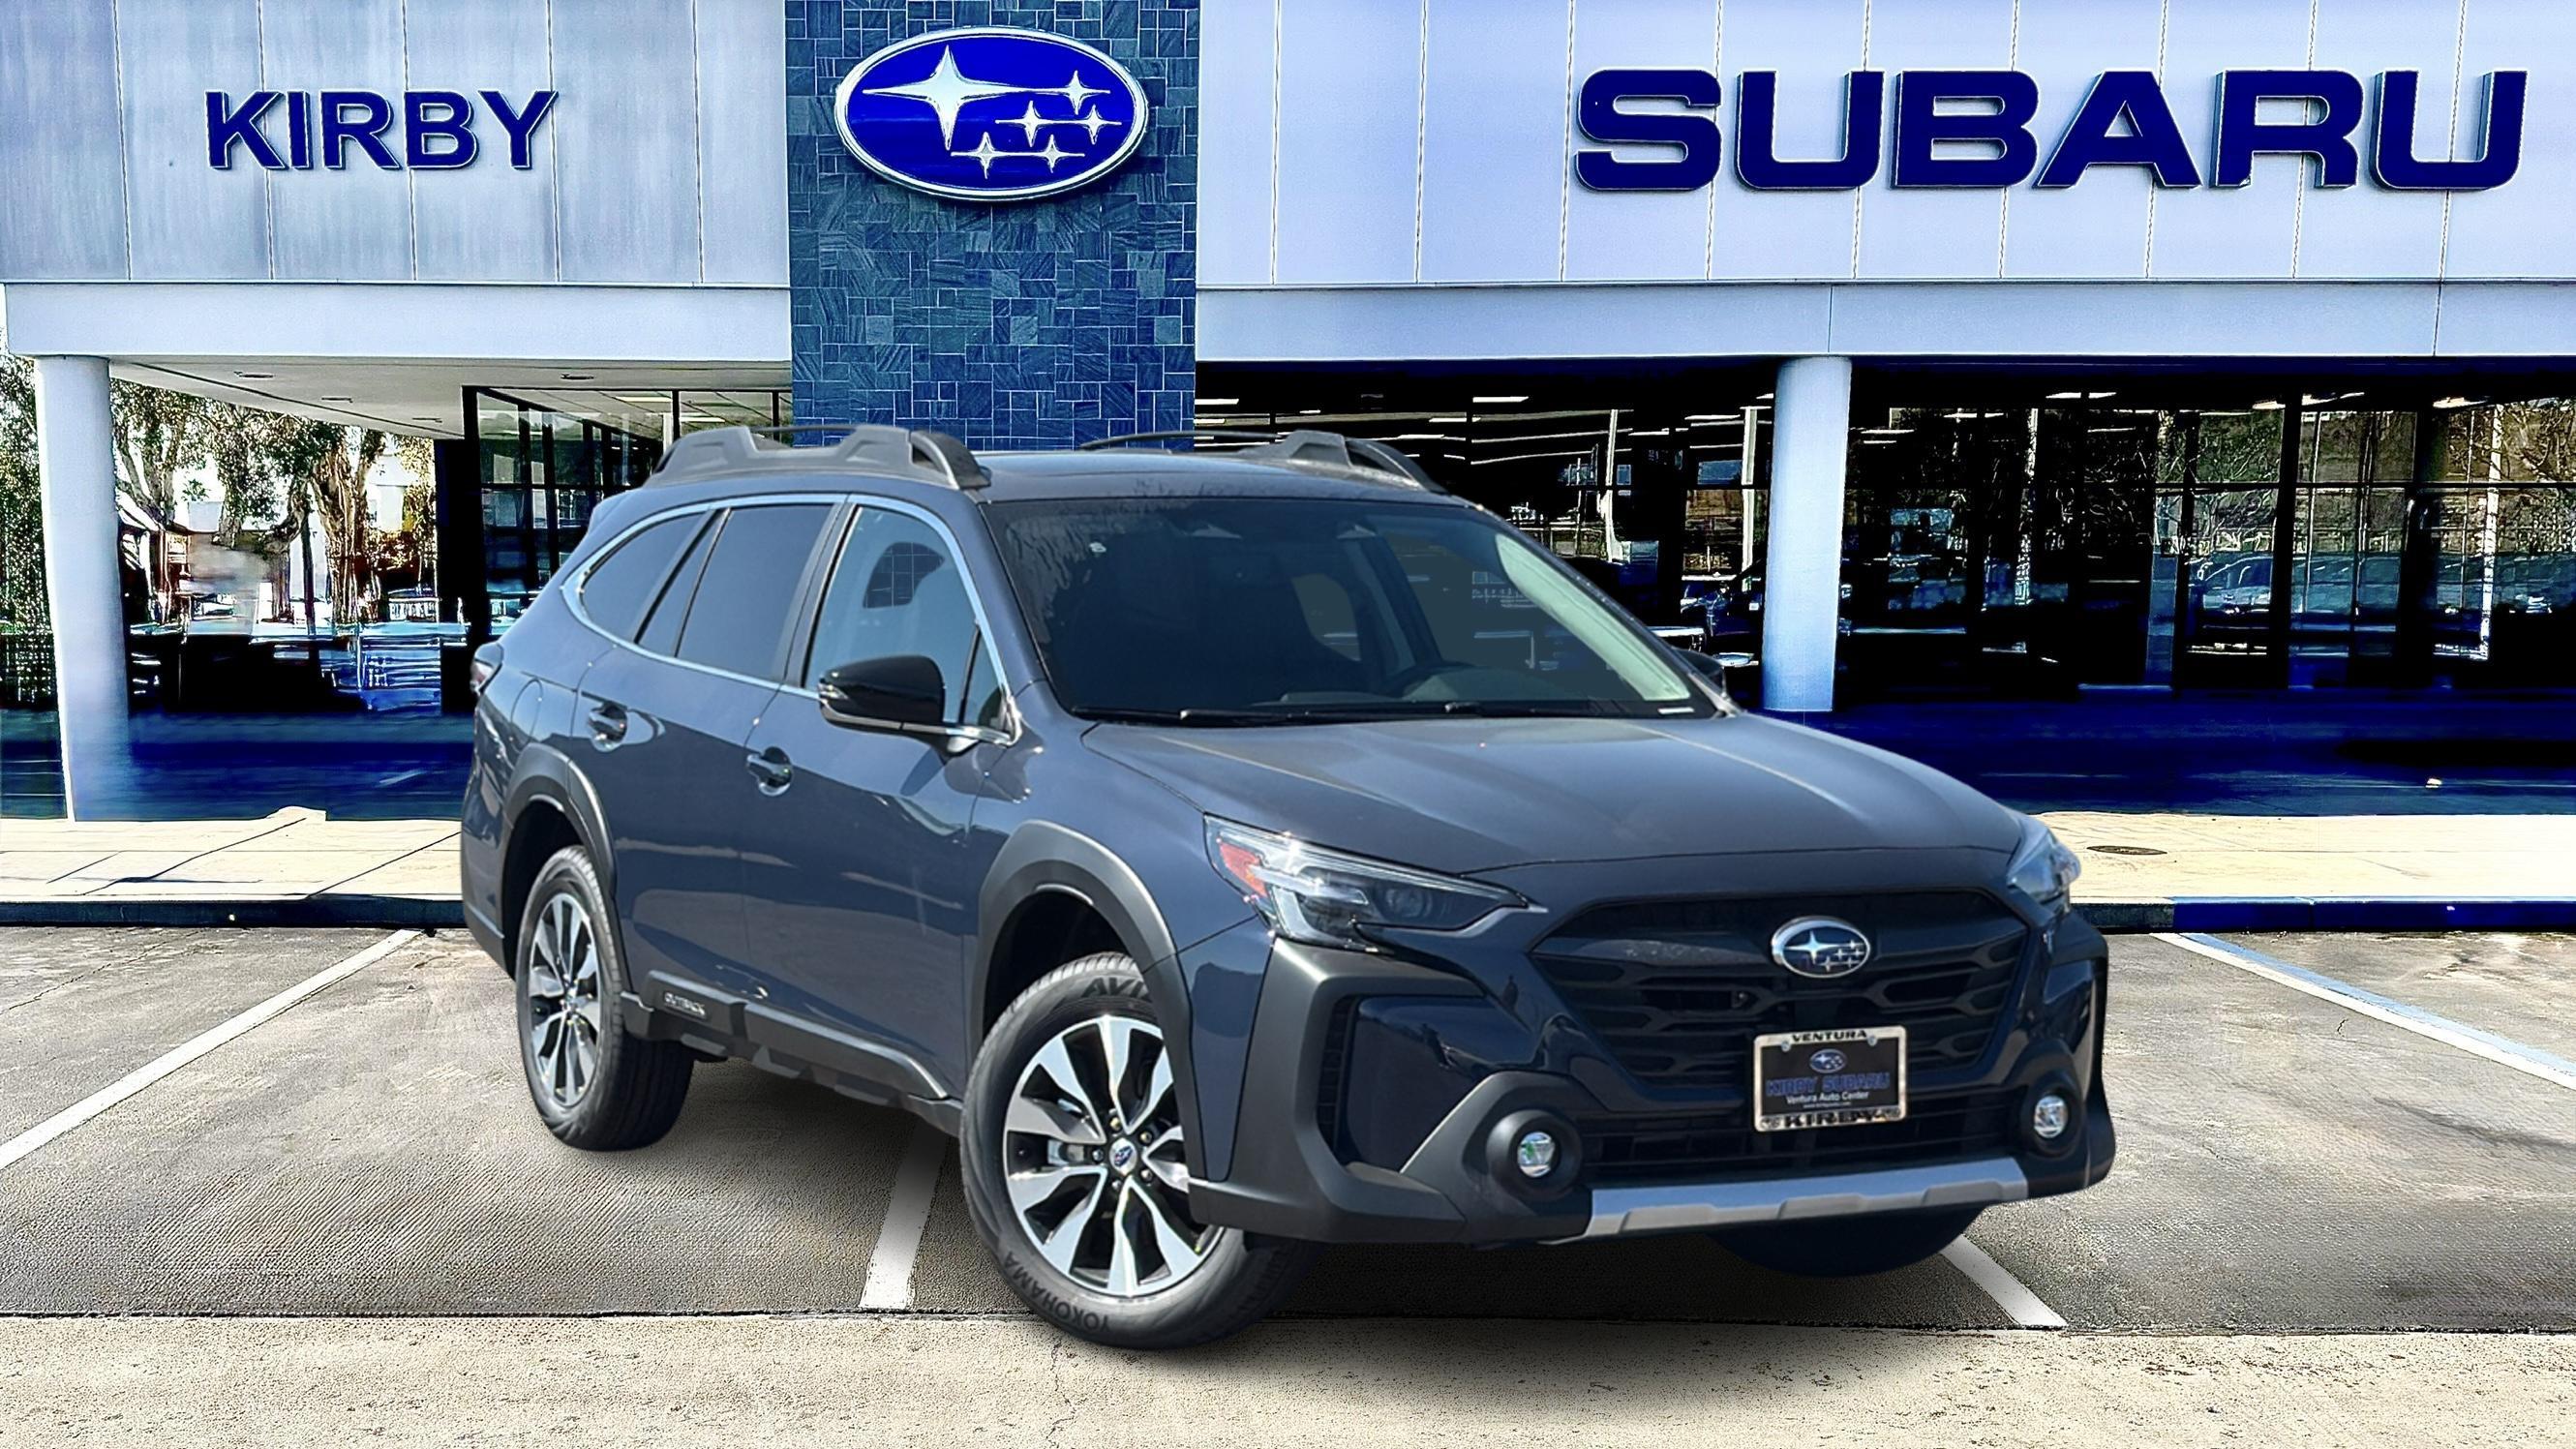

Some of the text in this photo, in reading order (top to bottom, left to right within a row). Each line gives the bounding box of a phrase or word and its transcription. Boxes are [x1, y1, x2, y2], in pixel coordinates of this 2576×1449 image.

[204, 89, 559, 170] KIRBY
[1574, 68, 2529, 191] SUBARU
[1080, 977, 1153, 1003] AVI
[1791, 1029, 1868, 1042] VENTURA
[1766, 1072, 1891, 1096] KIRBY SUBARU
[1786, 1090, 1870, 1104] Ventura Auto Center
[1004, 1251, 1111, 1333] YOKOHAMA
